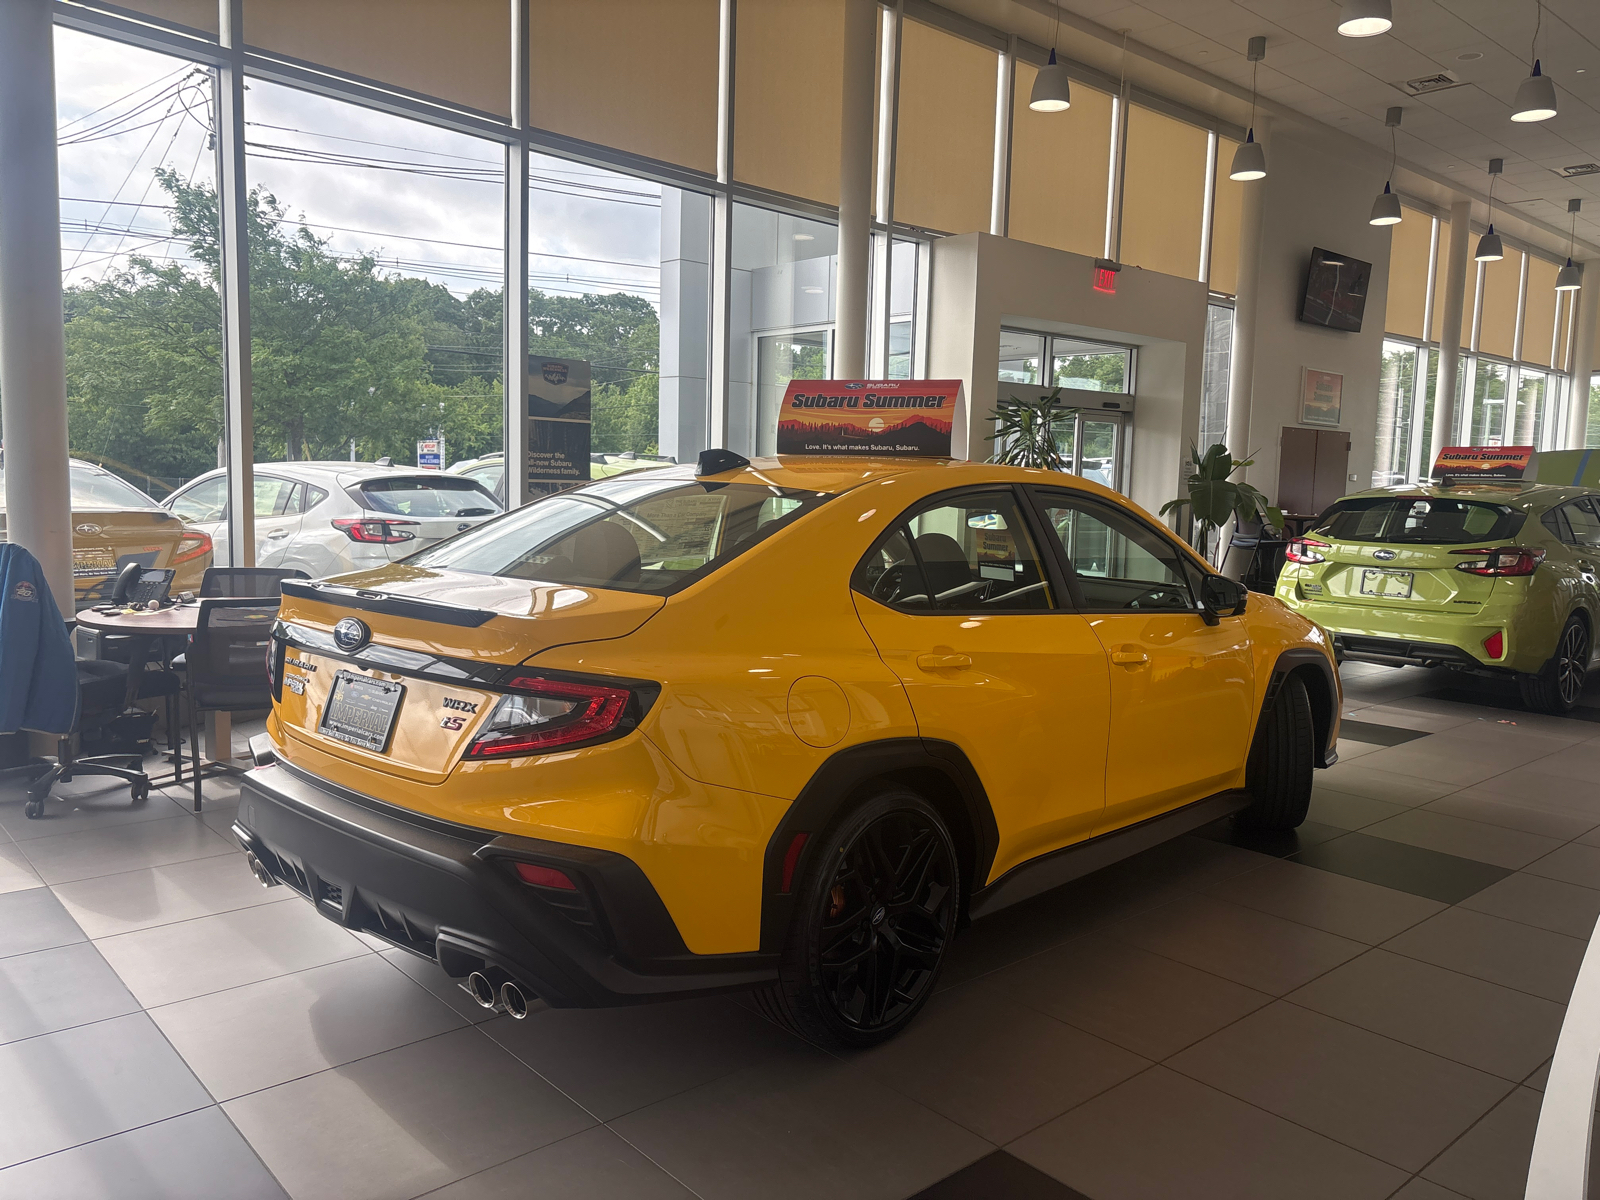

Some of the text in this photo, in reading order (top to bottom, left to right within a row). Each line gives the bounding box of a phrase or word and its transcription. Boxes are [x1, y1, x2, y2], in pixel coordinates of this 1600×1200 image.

[1098, 268, 1116, 289] EXIT
[791, 393, 947, 409] Subaru Summer
[1480, 453, 1524, 461] Summer
[561, 468, 580, 476] family.
[984, 532, 1007, 542] Subaru
[982, 542, 1009, 551] Summer
[73, 559, 116, 570] MPERIAL
[284, 656, 318, 673] SUBARU
[442, 697, 479, 715] WRX
[330, 701, 389, 735] IMPERIAL
